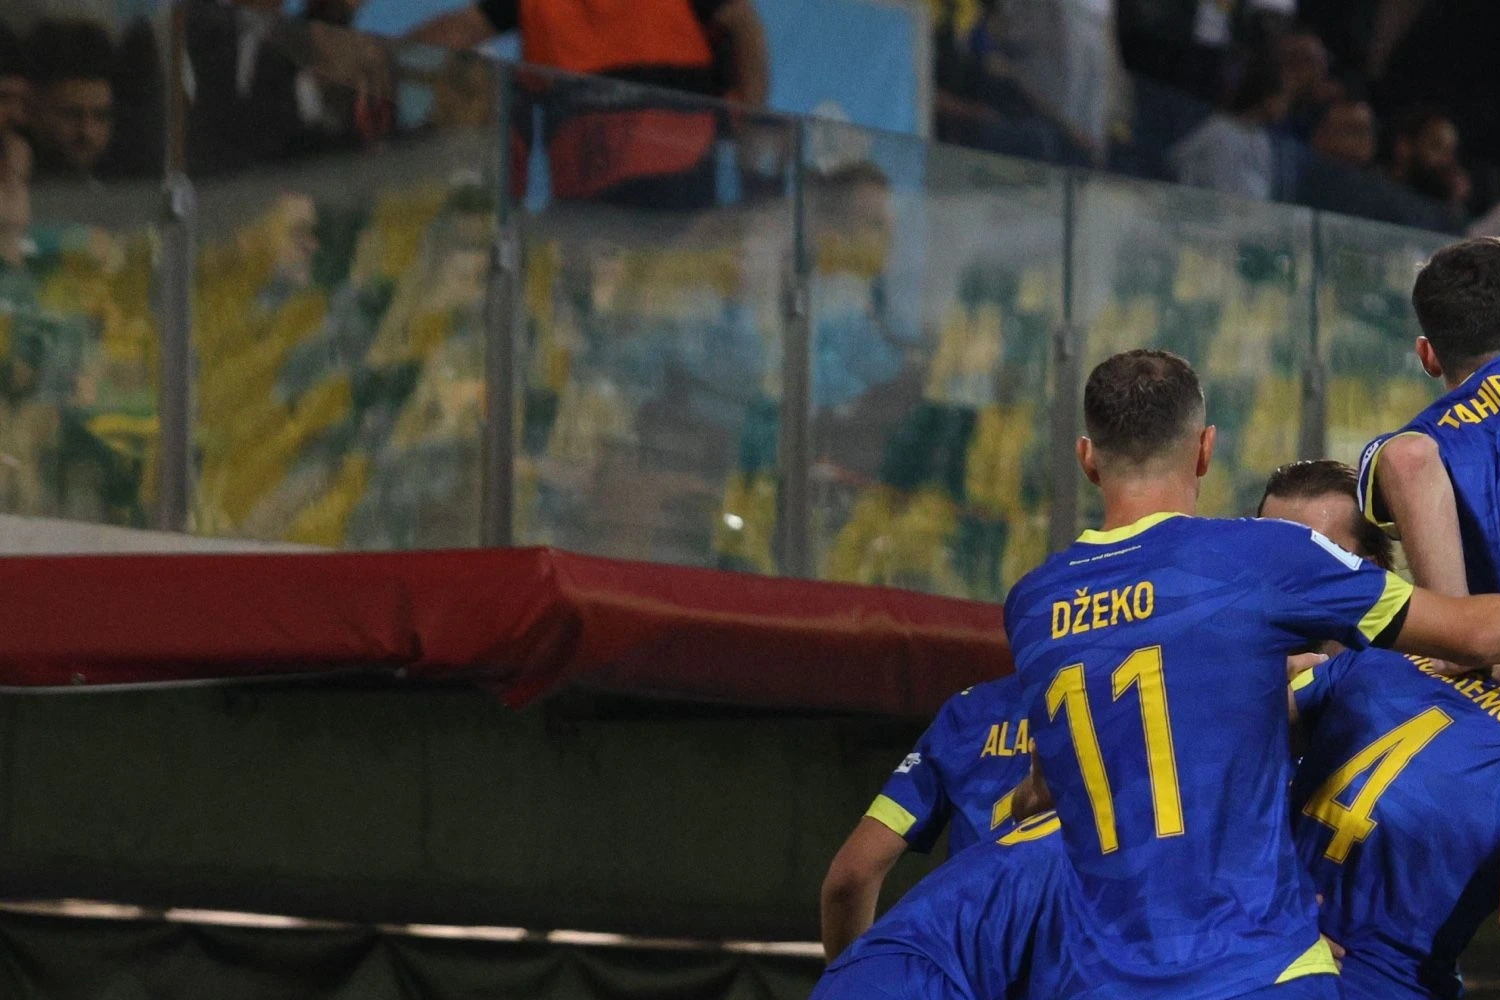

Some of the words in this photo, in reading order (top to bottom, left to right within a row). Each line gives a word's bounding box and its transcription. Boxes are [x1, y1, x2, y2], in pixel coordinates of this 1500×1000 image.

[1052, 581, 1154, 640] DŽEKO
[980, 718, 1034, 758] ALA
[1045, 645, 1184, 855] 11
[1303, 706, 1454, 865] 4
